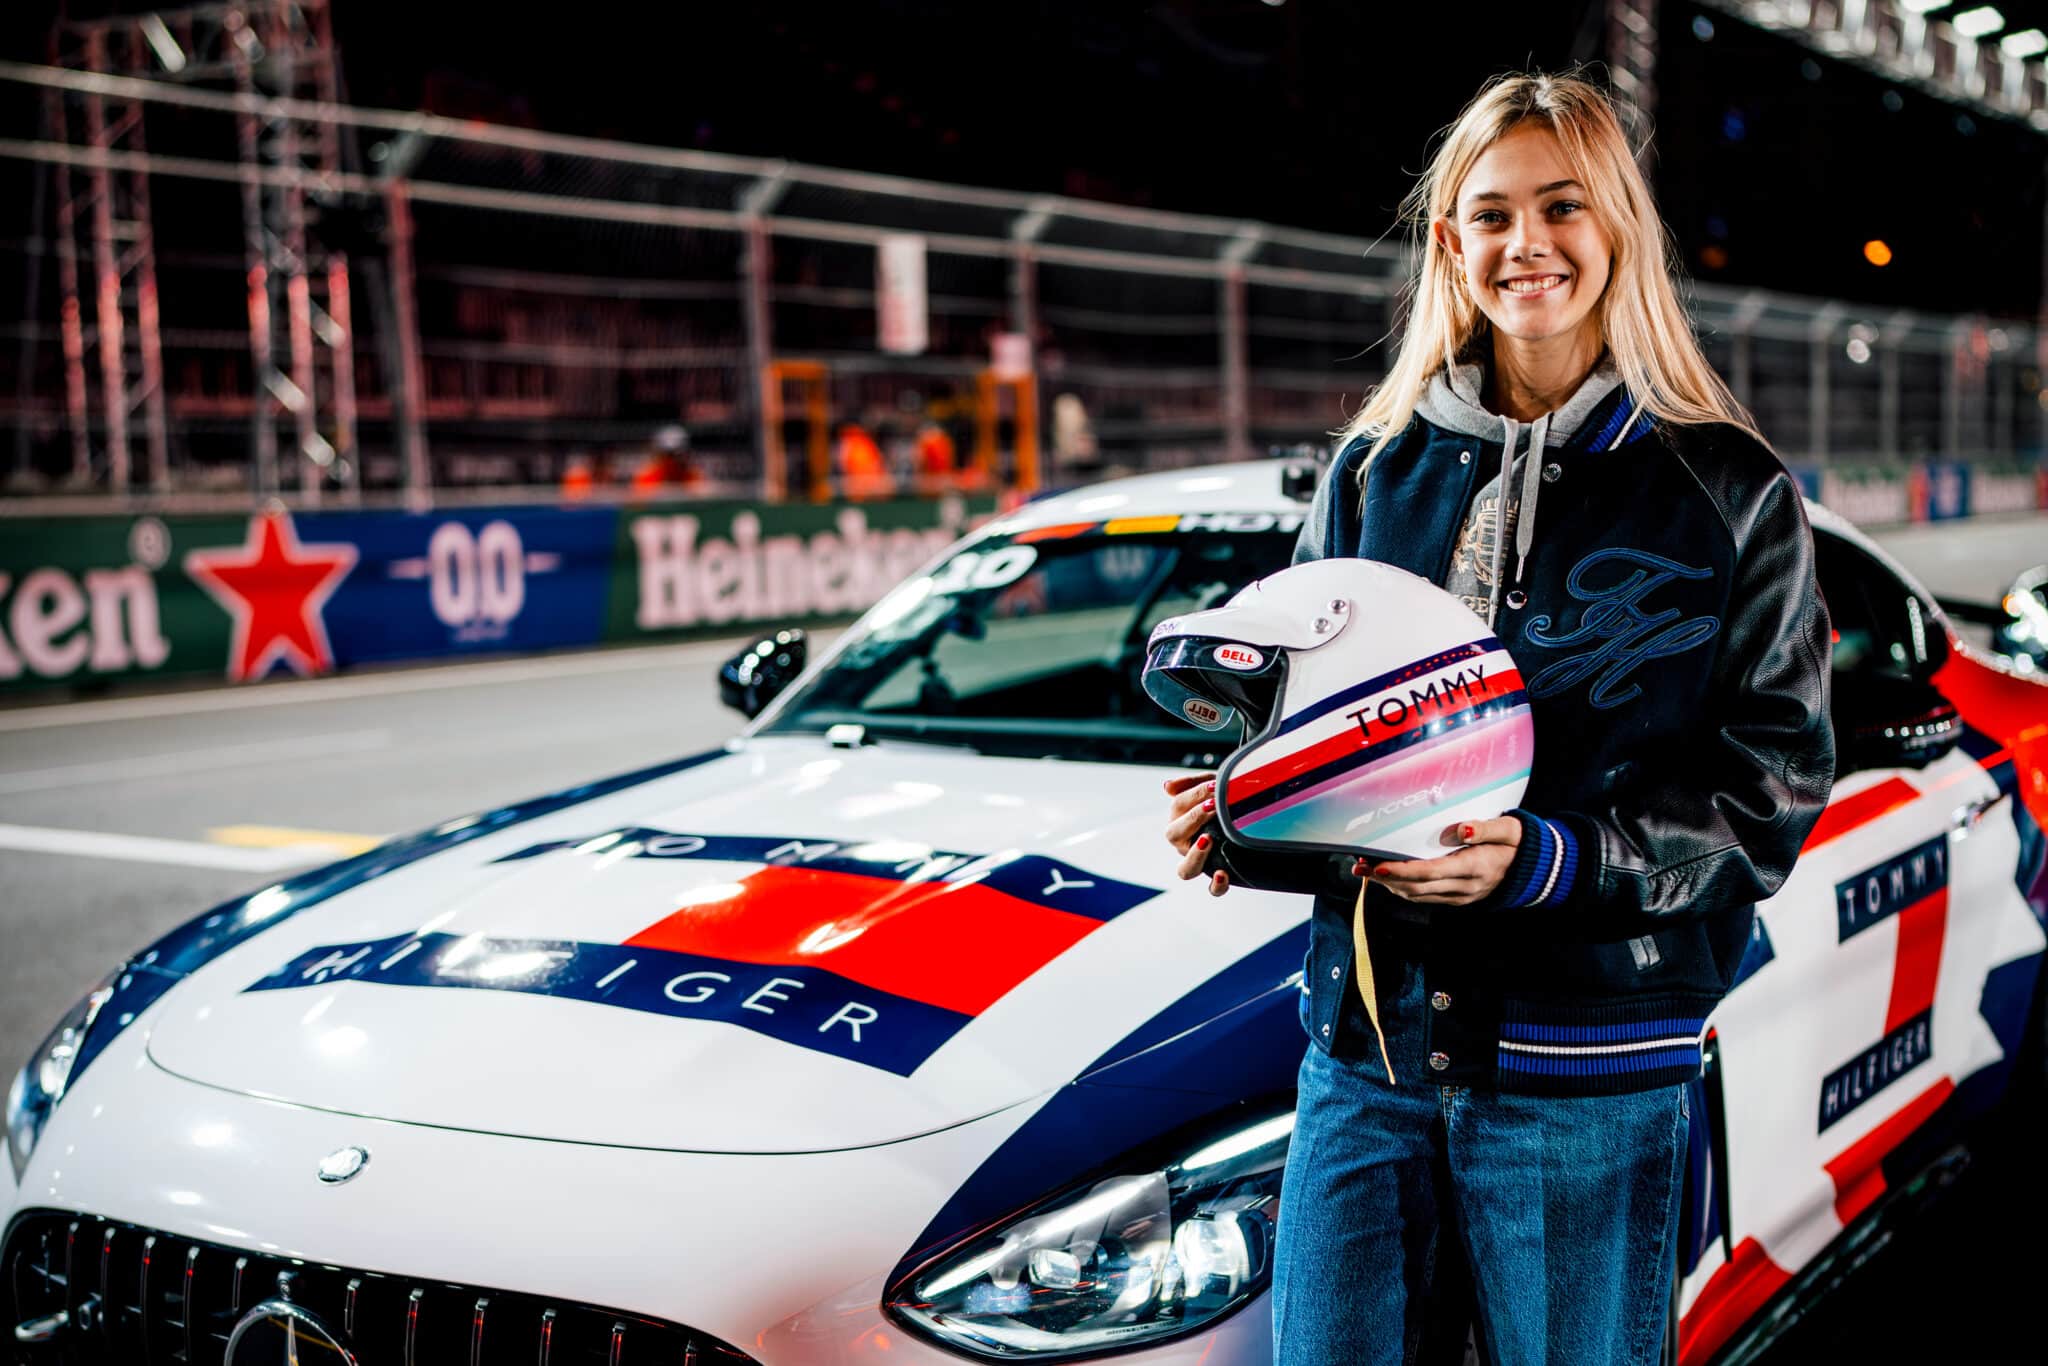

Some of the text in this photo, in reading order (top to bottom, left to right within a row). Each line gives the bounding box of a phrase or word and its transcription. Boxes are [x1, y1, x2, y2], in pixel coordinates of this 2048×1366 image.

[1221, 648, 1255, 664] BELL
[1346, 664, 1488, 737] TOMMY
[562, 839, 1095, 895] OMMY
[1844, 844, 1947, 924] TOMMY
[1825, 1021, 1929, 1117] HILFIGER
